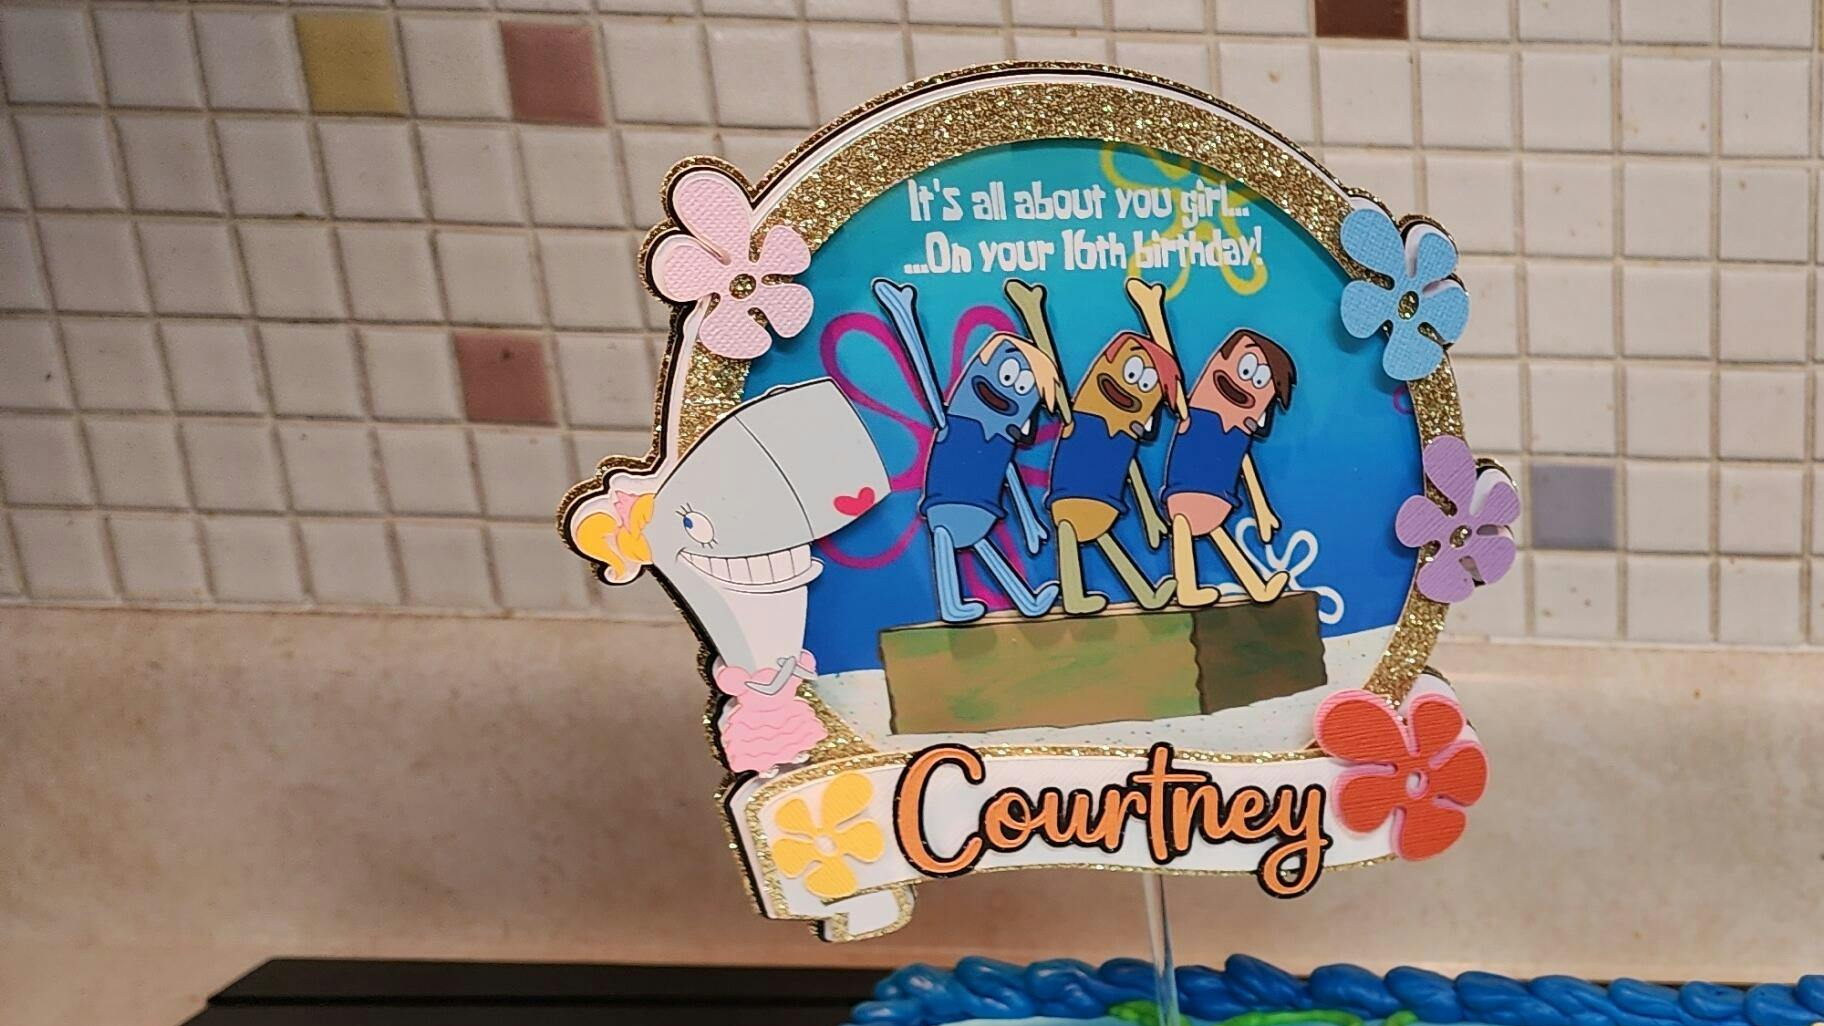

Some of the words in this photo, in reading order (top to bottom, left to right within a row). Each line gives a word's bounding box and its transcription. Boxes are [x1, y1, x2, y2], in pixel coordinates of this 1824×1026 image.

[907, 178, 962, 222] It's
[972, 180, 1008, 221] all
[1015, 180, 1106, 221] about
[1115, 186, 1172, 219] you
[1180, 178, 1251, 228] girl...
[903, 230, 972, 275] ...On
[978, 239, 1056, 272] your
[1061, 228, 1128, 271] 16th
[1134, 225, 1263, 269] birthday!
[893, 742, 1334, 899] Courtney
